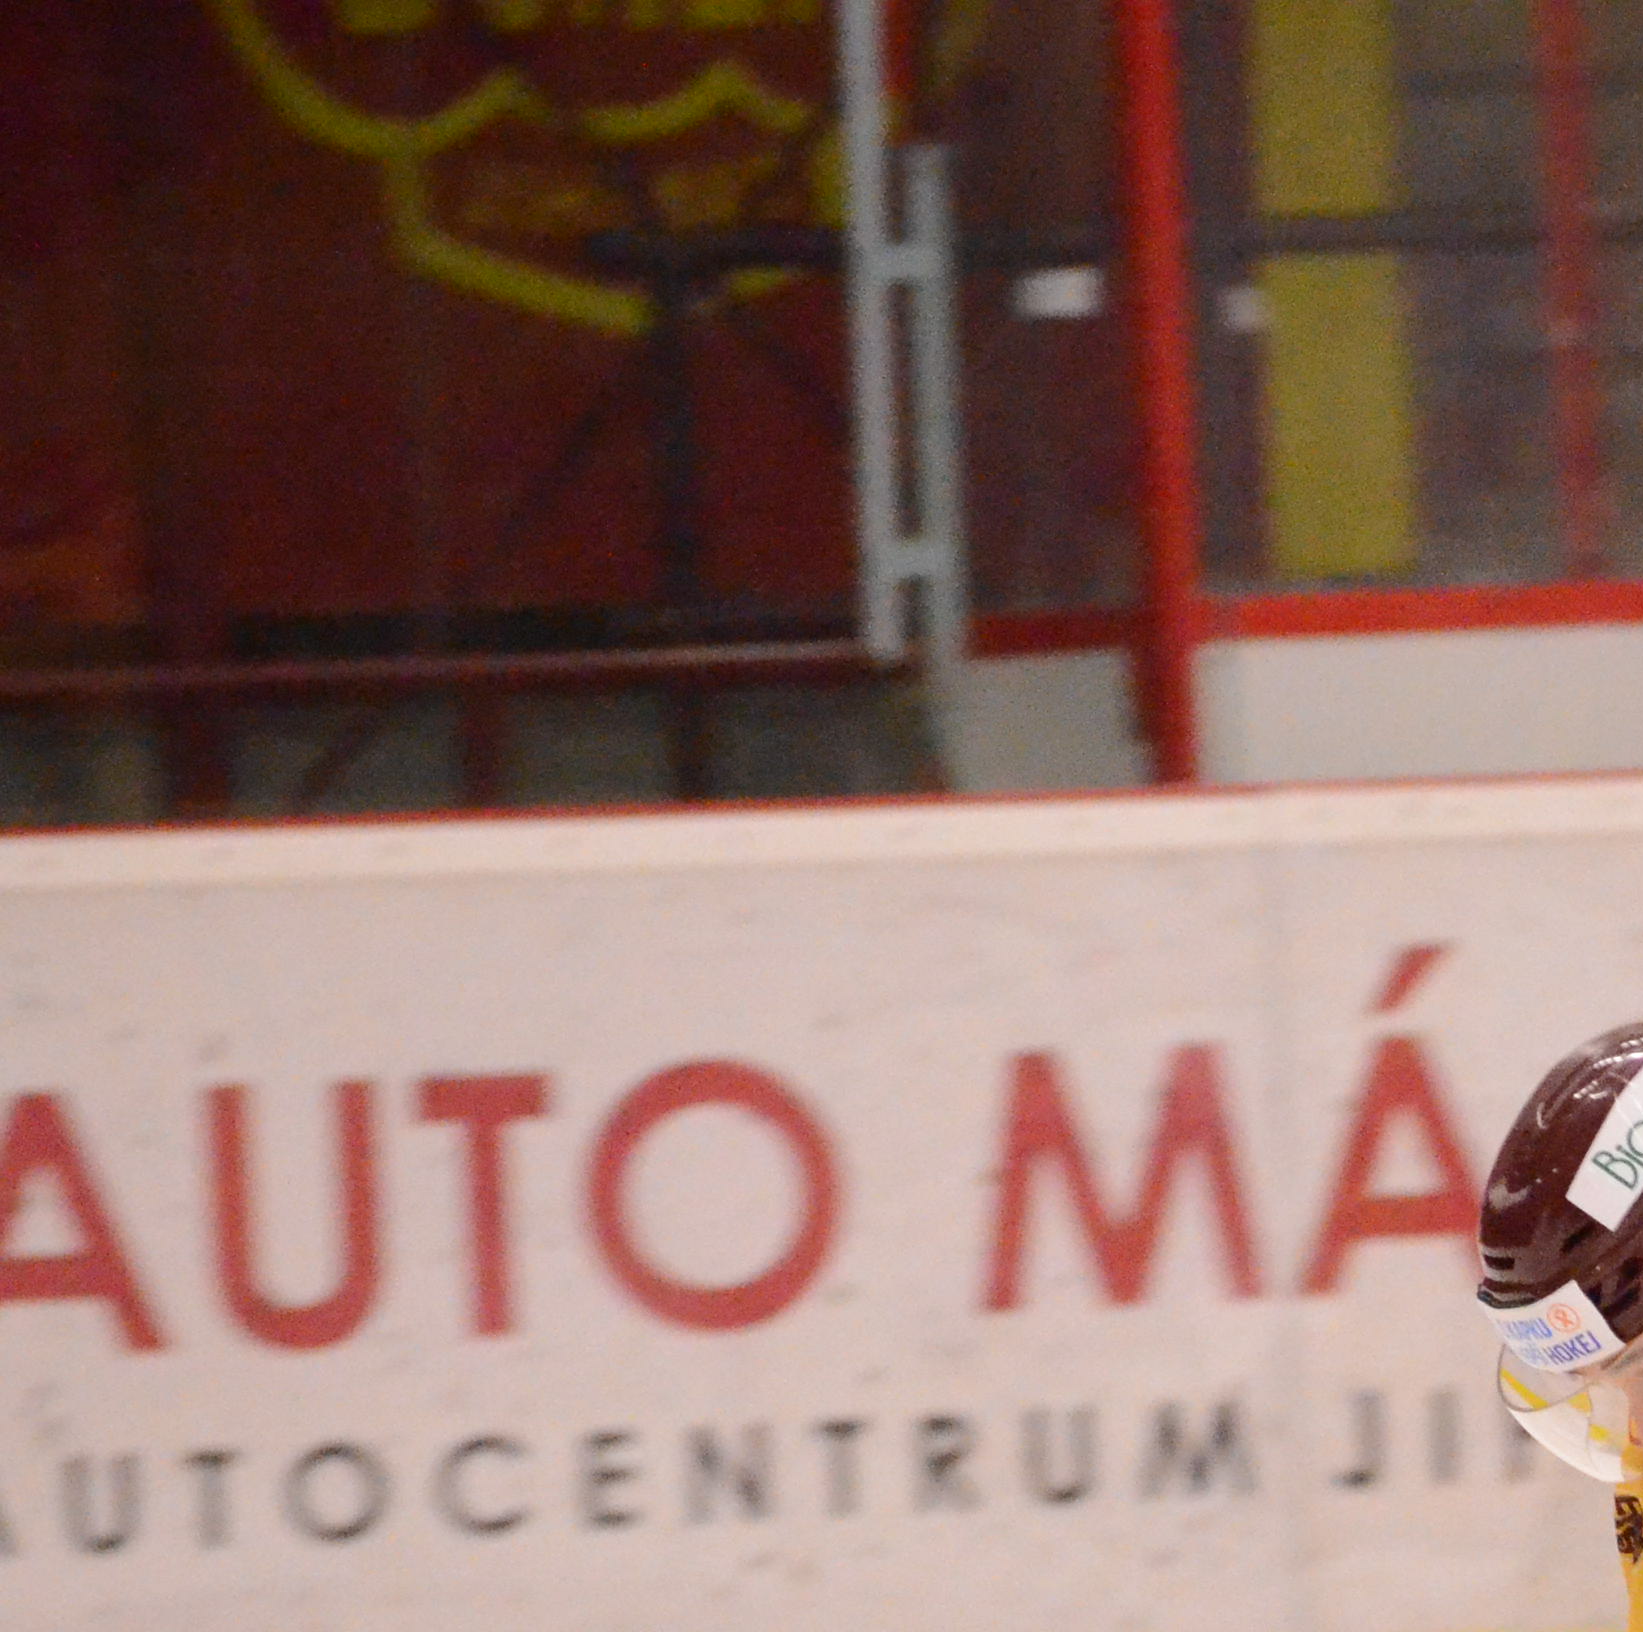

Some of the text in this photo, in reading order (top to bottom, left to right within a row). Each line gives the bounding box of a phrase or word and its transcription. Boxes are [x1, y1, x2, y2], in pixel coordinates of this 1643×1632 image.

[0, 938, 1484, 1354] AUTO MÁ
[1541, 1329, 1603, 1366] HOKEJ
[0, 1398, 1261, 1558] UTOCENTRUM
